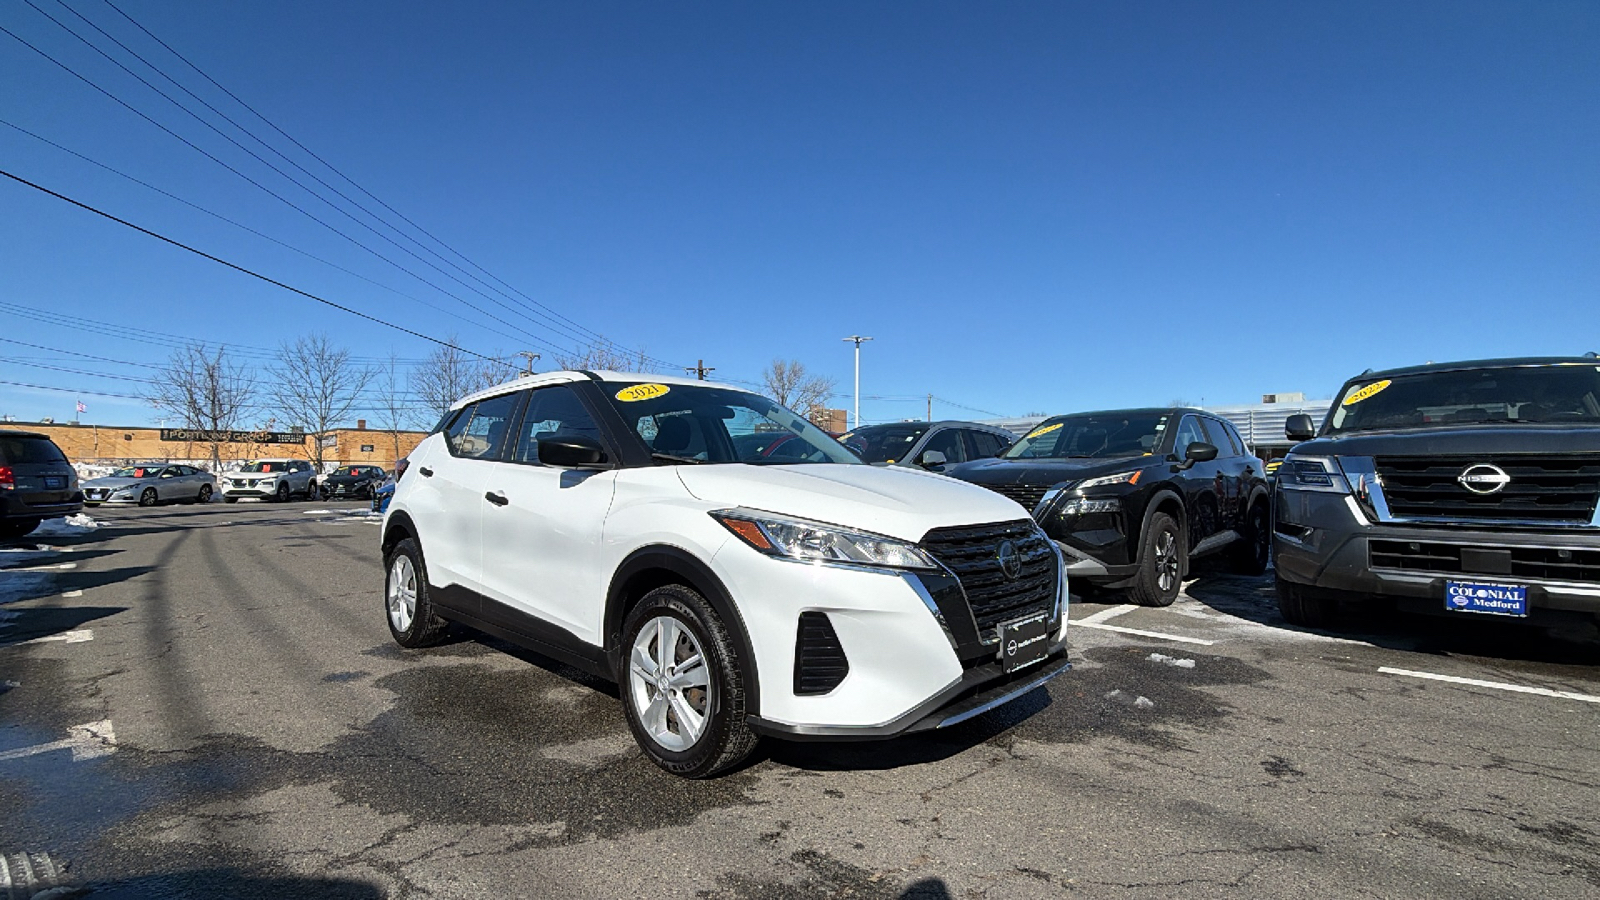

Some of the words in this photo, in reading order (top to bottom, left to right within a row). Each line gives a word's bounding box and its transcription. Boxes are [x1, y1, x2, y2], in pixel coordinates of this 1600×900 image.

[626, 385, 659, 399] 2021
[1351, 383, 1383, 401] 2022
[1449, 587, 1523, 600] COLONIAL
[1473, 599, 1520, 609] Medford
